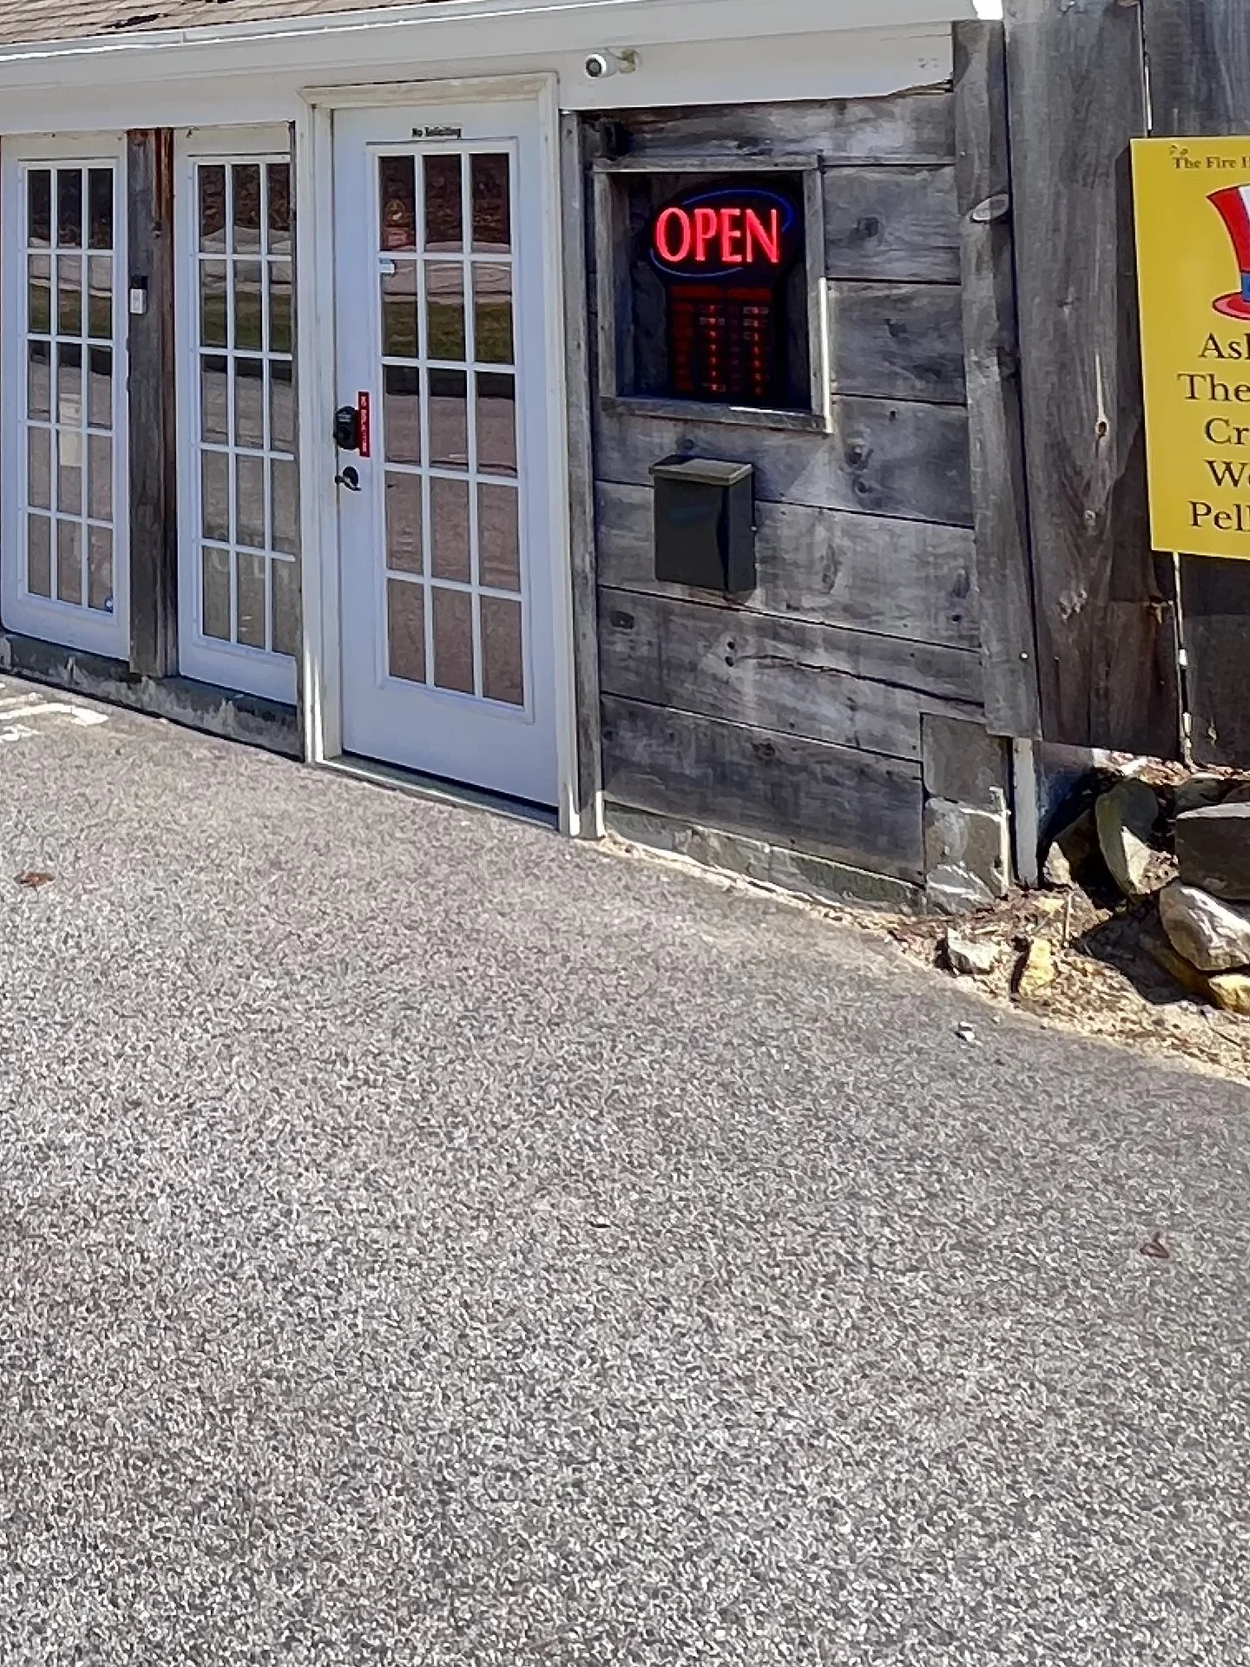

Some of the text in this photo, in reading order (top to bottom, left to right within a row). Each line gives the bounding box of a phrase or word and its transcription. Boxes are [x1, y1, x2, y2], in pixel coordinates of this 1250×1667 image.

[1172, 156, 1201, 169] The
[1206, 156, 1237, 169] Fire
[656, 207, 778, 263] OPEN
[1204, 458, 1250, 488] W
